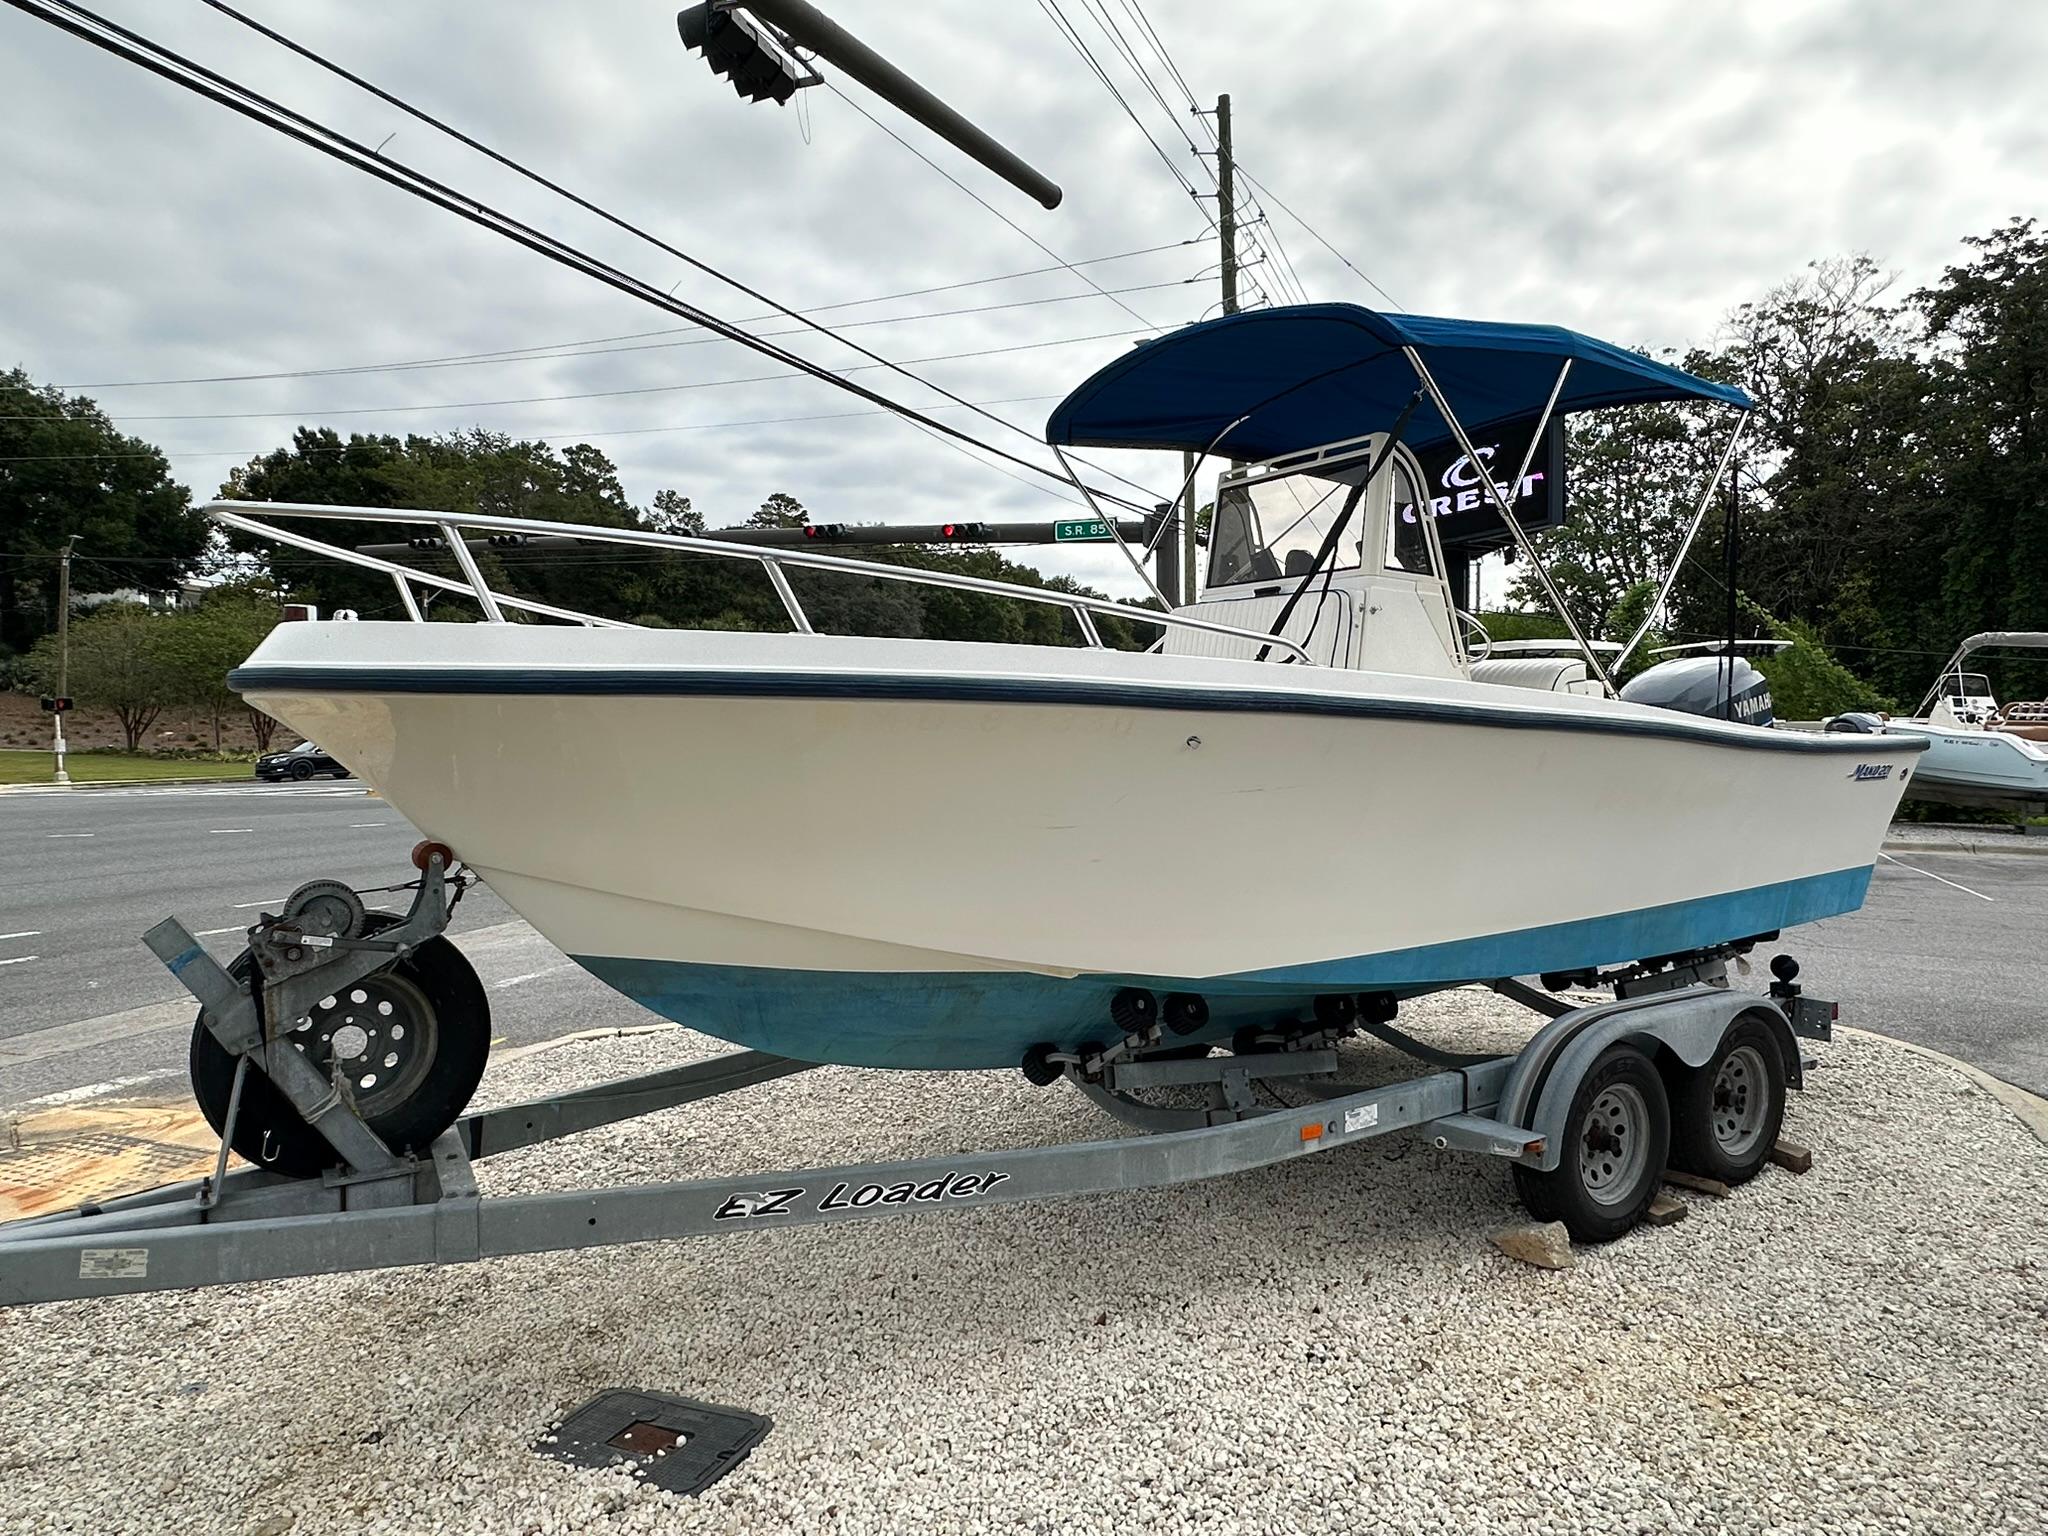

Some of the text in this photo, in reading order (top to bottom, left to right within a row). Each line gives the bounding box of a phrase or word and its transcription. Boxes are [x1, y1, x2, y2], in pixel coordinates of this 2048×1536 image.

[1403, 472, 1544, 524] CREST
[1064, 524, 1106, 536] S.R. 85
[1733, 691, 1773, 718] YAMAH
[713, 1171, 1010, 1220] EZ Loader
